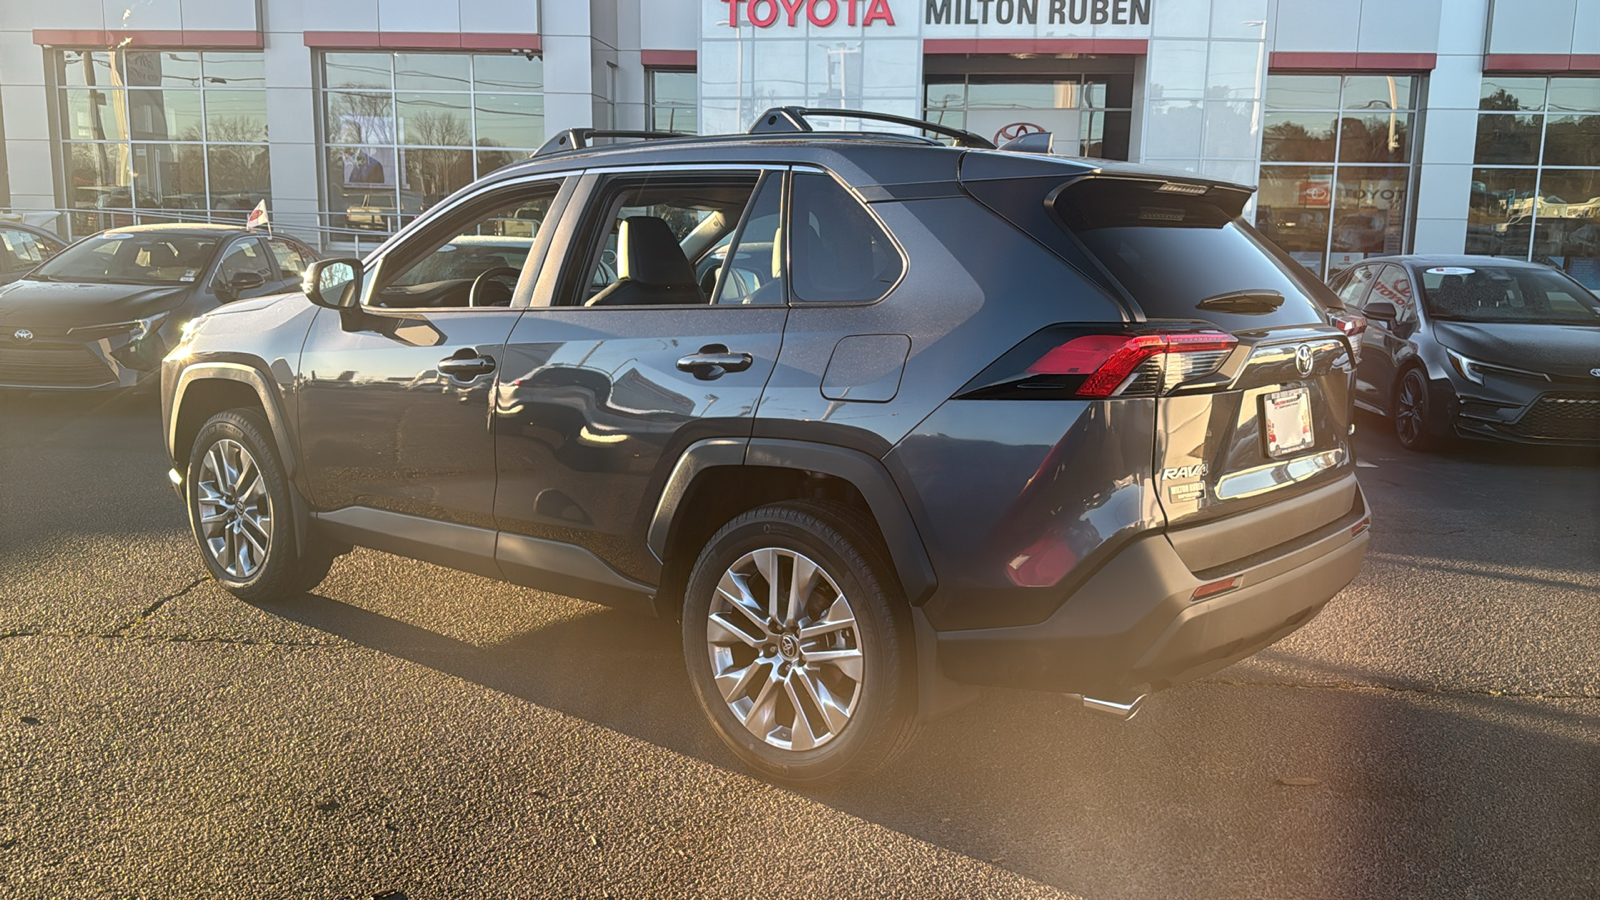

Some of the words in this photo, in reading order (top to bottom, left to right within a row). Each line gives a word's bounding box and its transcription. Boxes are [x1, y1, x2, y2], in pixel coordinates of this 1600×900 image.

[721, 0, 896, 28] TOYOTA
[925, 0, 1037, 25] MILTON
[1048, 0, 1150, 25] RUBEN
[1161, 463, 1209, 481] RAV4
